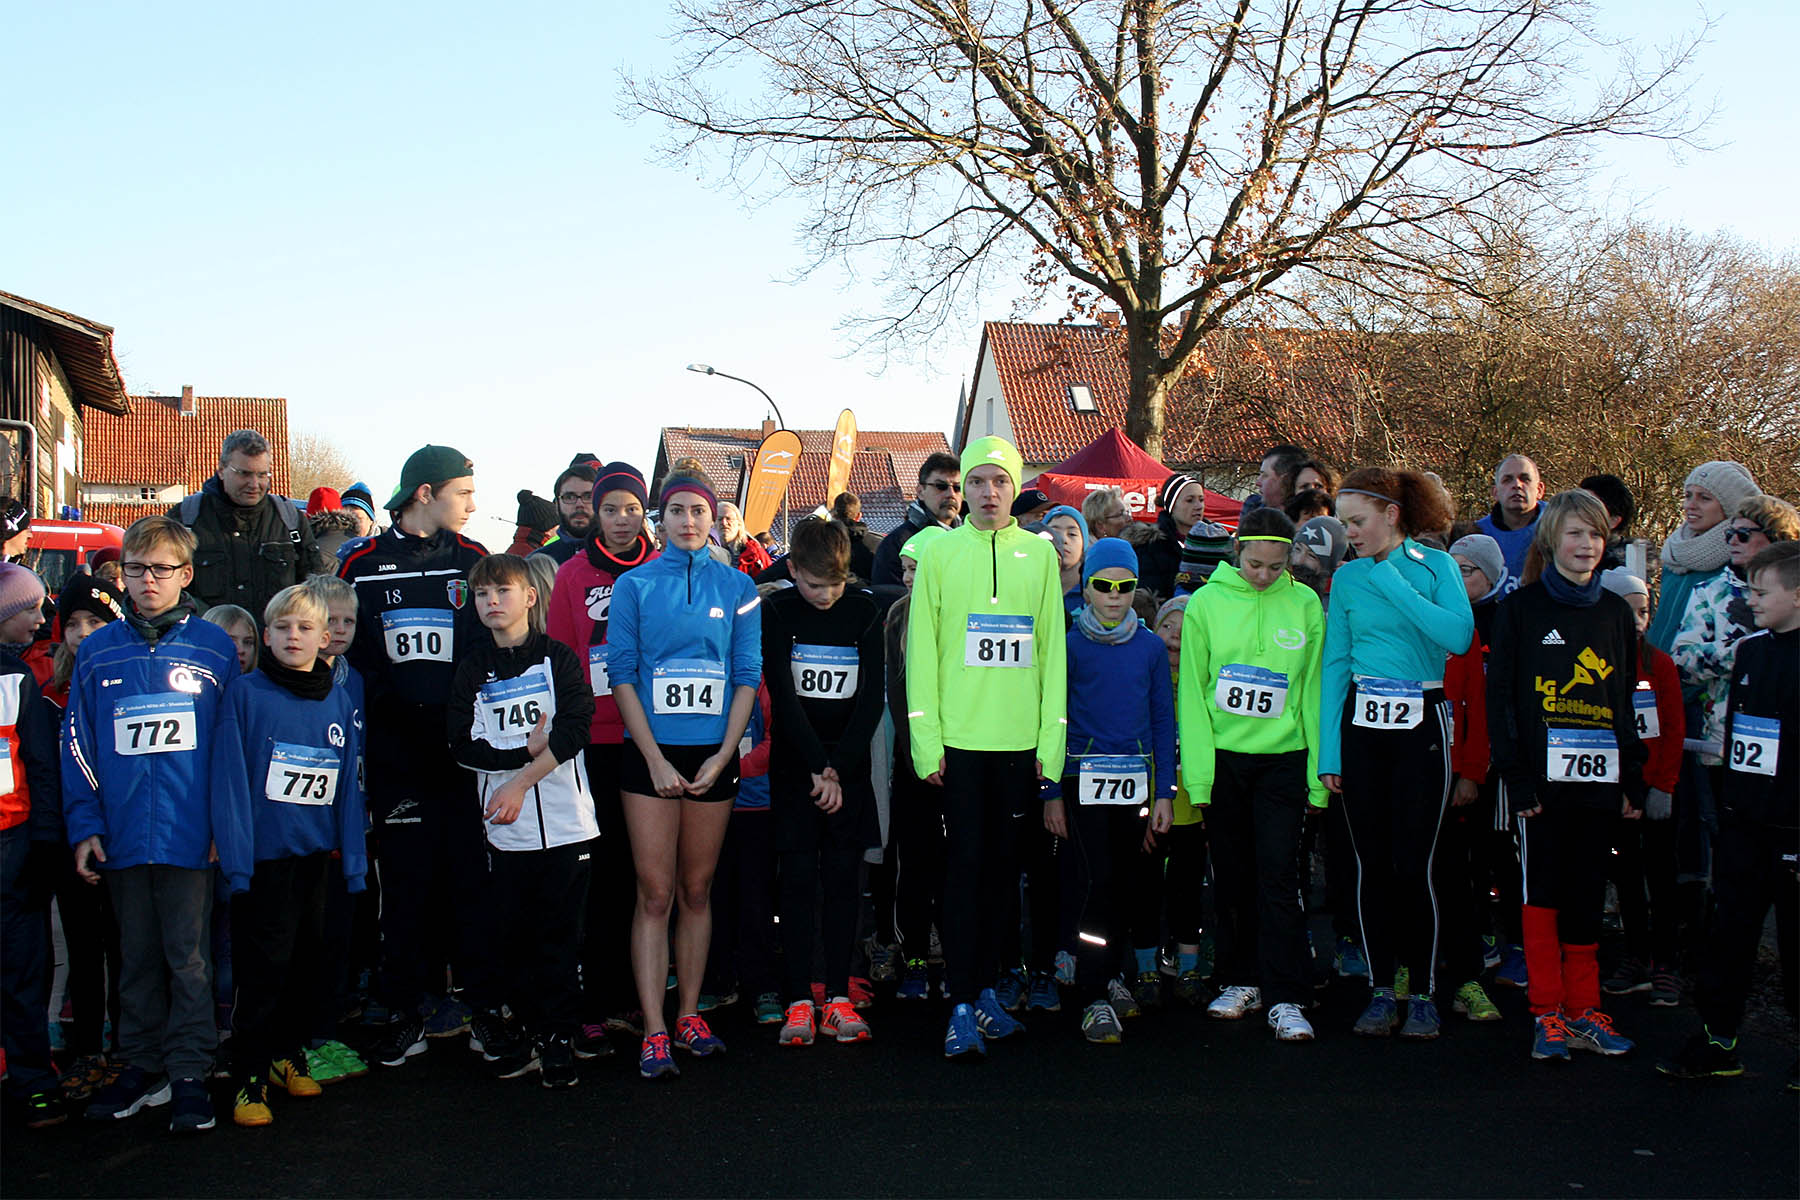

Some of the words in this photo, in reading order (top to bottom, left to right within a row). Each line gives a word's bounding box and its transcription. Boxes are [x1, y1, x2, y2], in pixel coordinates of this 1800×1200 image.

[378, 564, 397, 572] JAKO
[384, 588, 402, 605] 18
[395, 631, 441, 657] 810
[978, 638, 1020, 662] 811
[801, 668, 848, 693] 807
[1535, 675, 1557, 696] LG
[665, 683, 713, 708] 814
[1226, 686, 1273, 714] 815
[492, 700, 541, 732] 746
[1365, 700, 1410, 724] 812
[127, 719, 182, 749] 772
[1561, 753, 1608, 778] 768
[1732, 740, 1764, 768] 92
[282, 770, 329, 800] 773
[1092, 778, 1137, 800] 770
